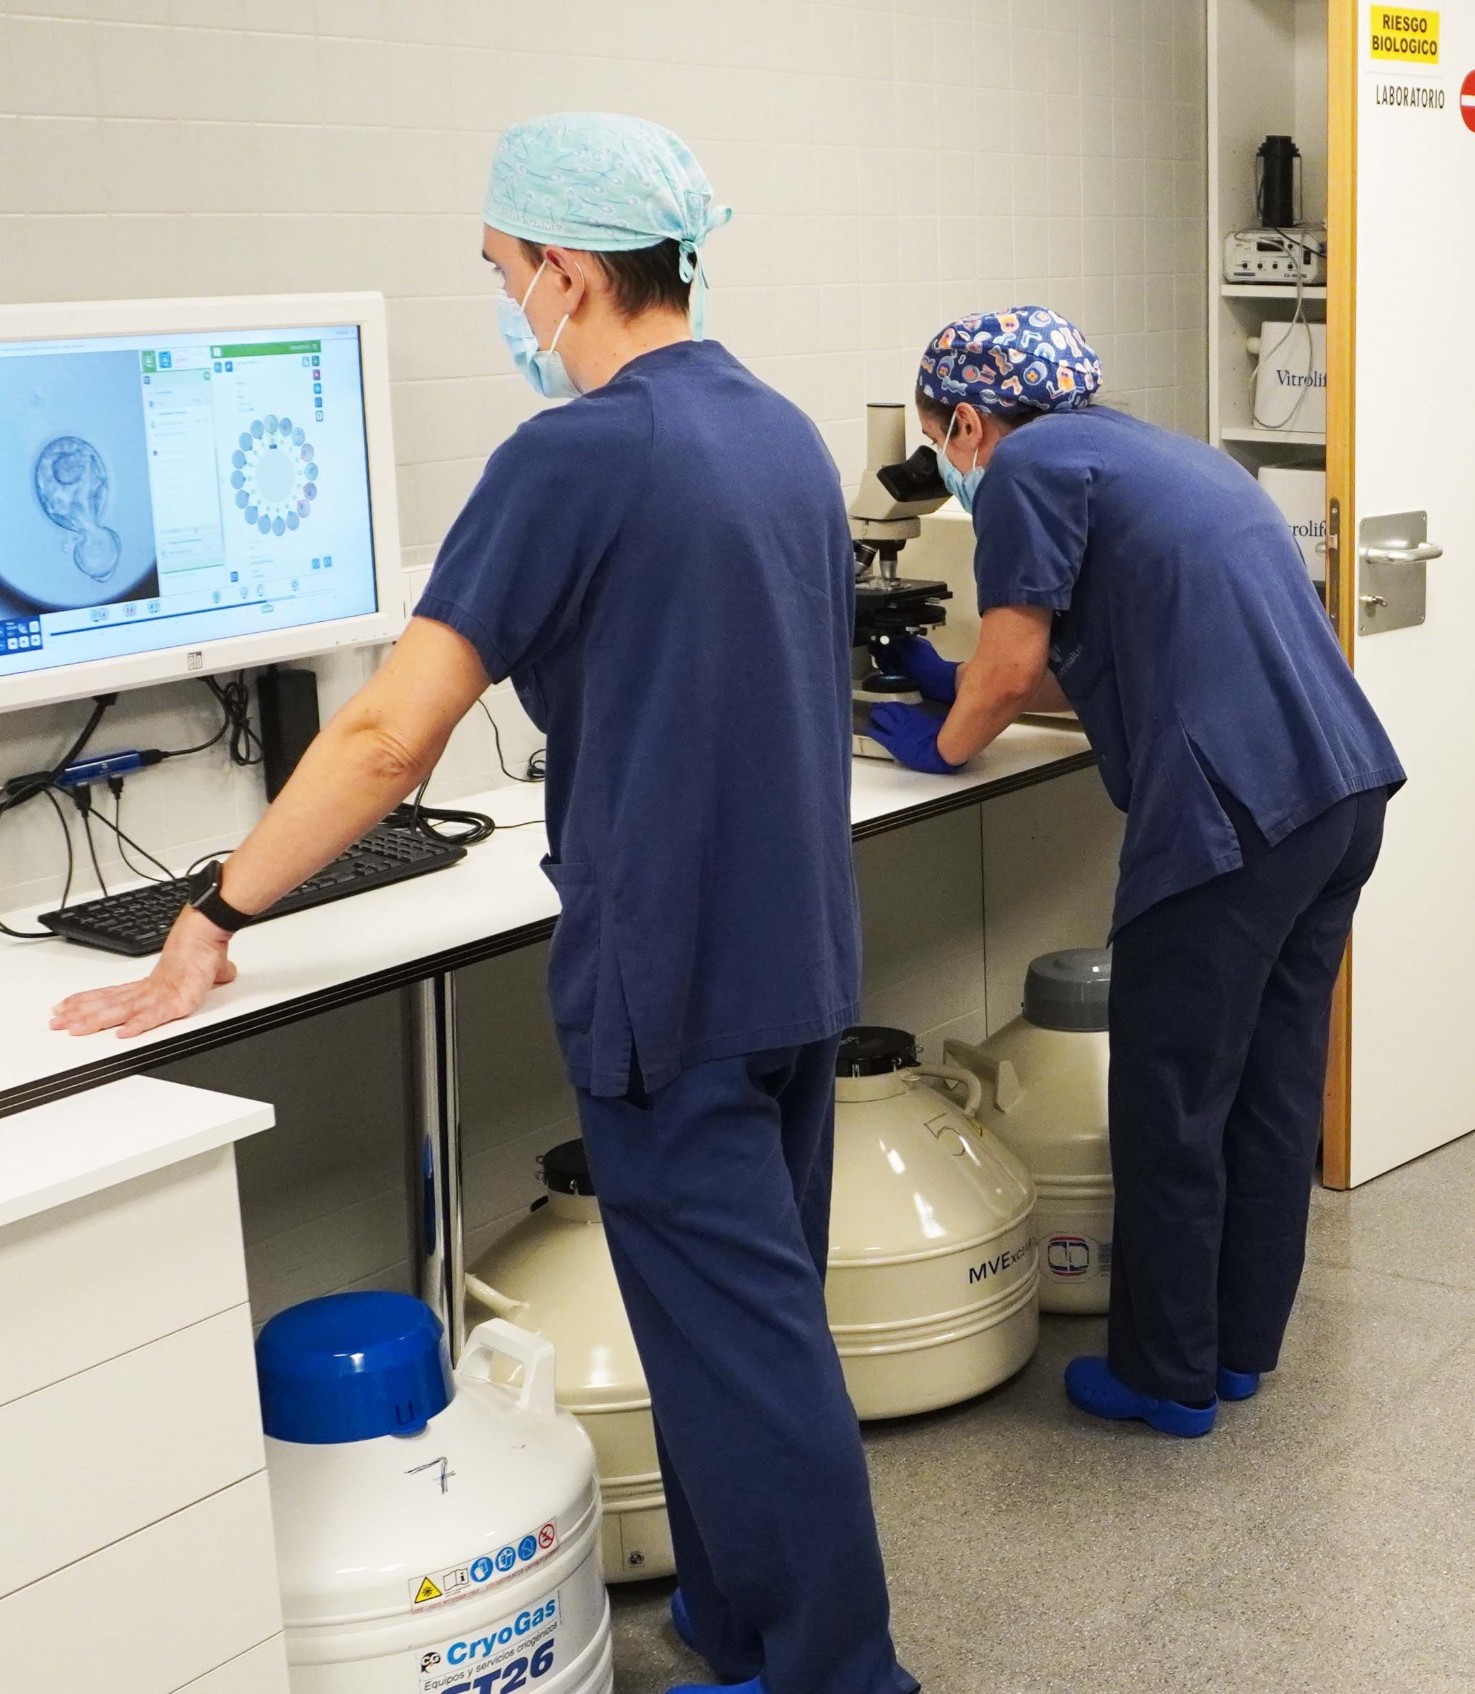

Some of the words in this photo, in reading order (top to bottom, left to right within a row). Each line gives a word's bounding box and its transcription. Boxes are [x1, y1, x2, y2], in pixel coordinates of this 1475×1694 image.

[1383, 14, 1427, 33] RIESGO
[1372, 35, 1438, 56] BIOLOGICO
[1376, 84, 1445, 109] LABORATORIO
[1288, 520, 1327, 537] rolif
[923, 1112, 967, 1157] 5
[404, 1456, 456, 1495] 7
[446, 1599, 556, 1665] CryoGas
[424, 1670, 465, 1691] Equipos
[467, 1668, 474, 1678] y
[476, 1648, 515, 1672] servicios
[516, 1621, 558, 1652] criogénicos
